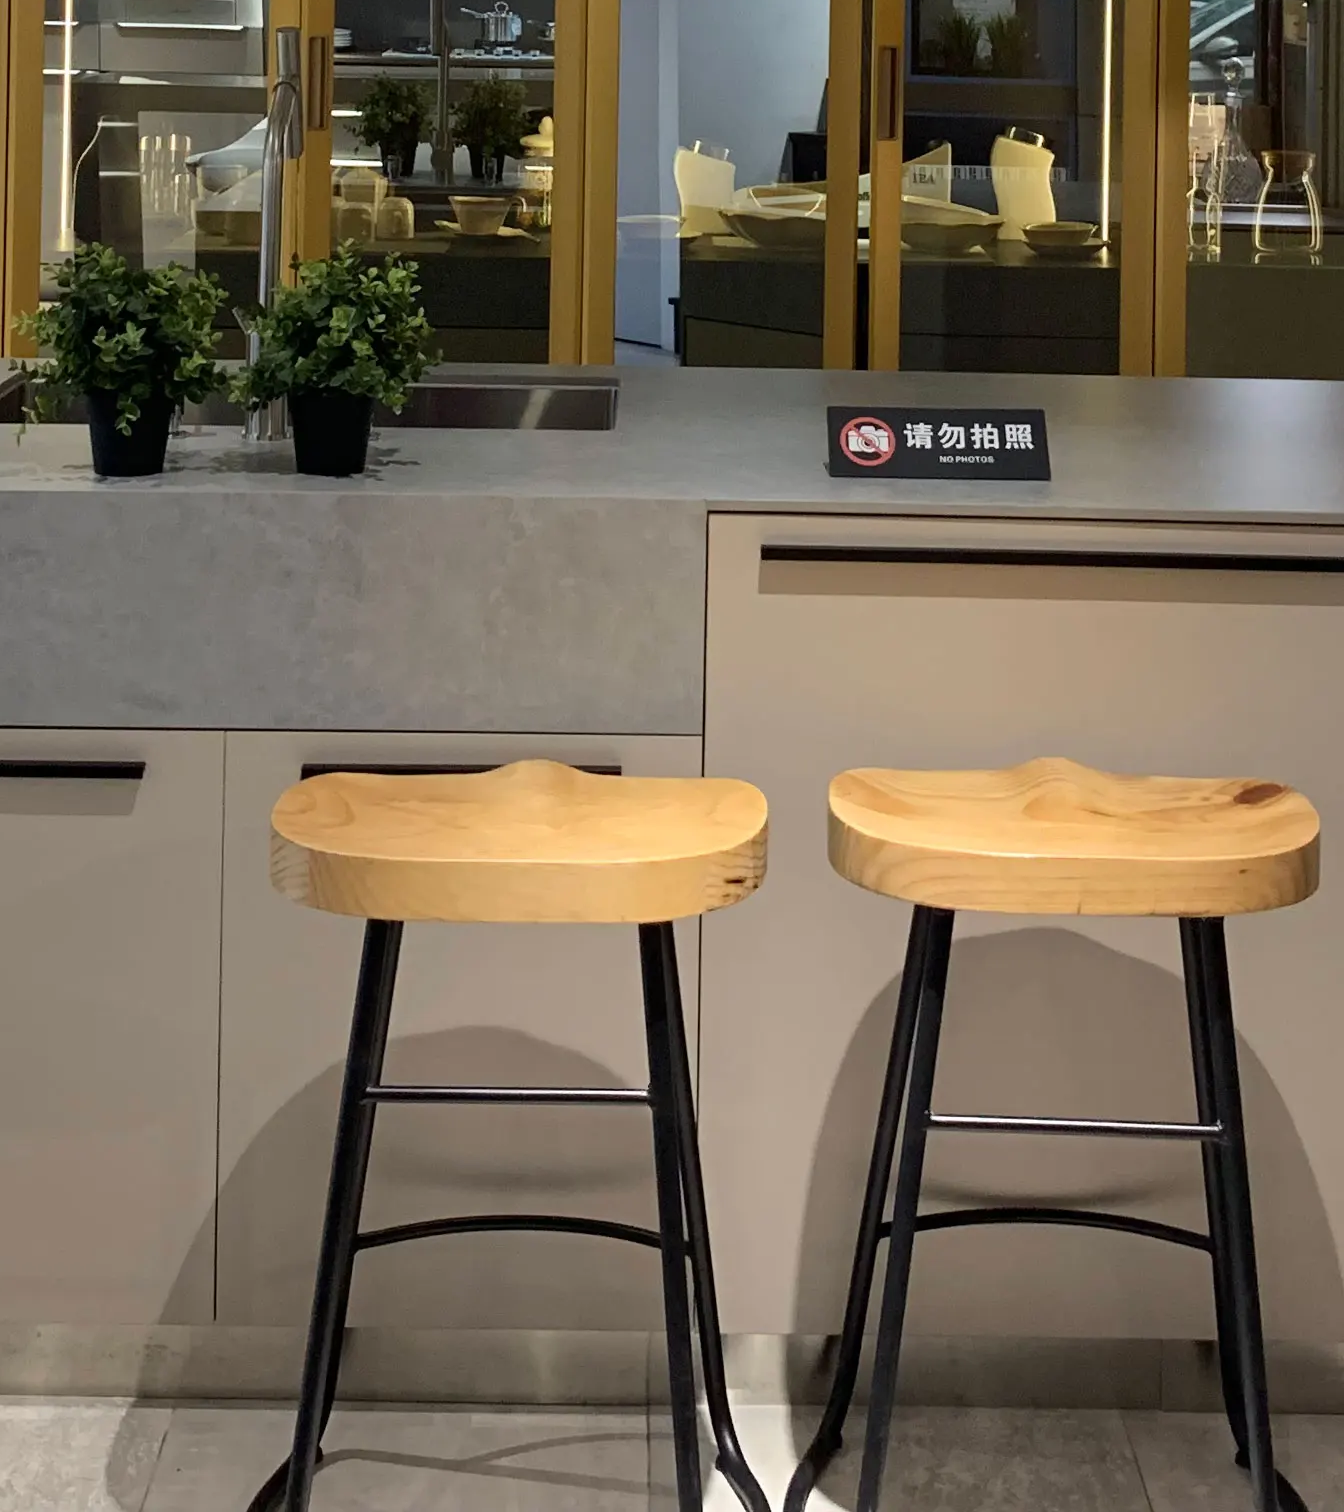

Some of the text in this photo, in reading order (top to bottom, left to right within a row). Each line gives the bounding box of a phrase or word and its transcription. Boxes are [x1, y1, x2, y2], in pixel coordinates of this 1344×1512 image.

[903, 422, 1035, 450] 请勿拍照
[939, 455, 995, 464] NO PHOTOS
